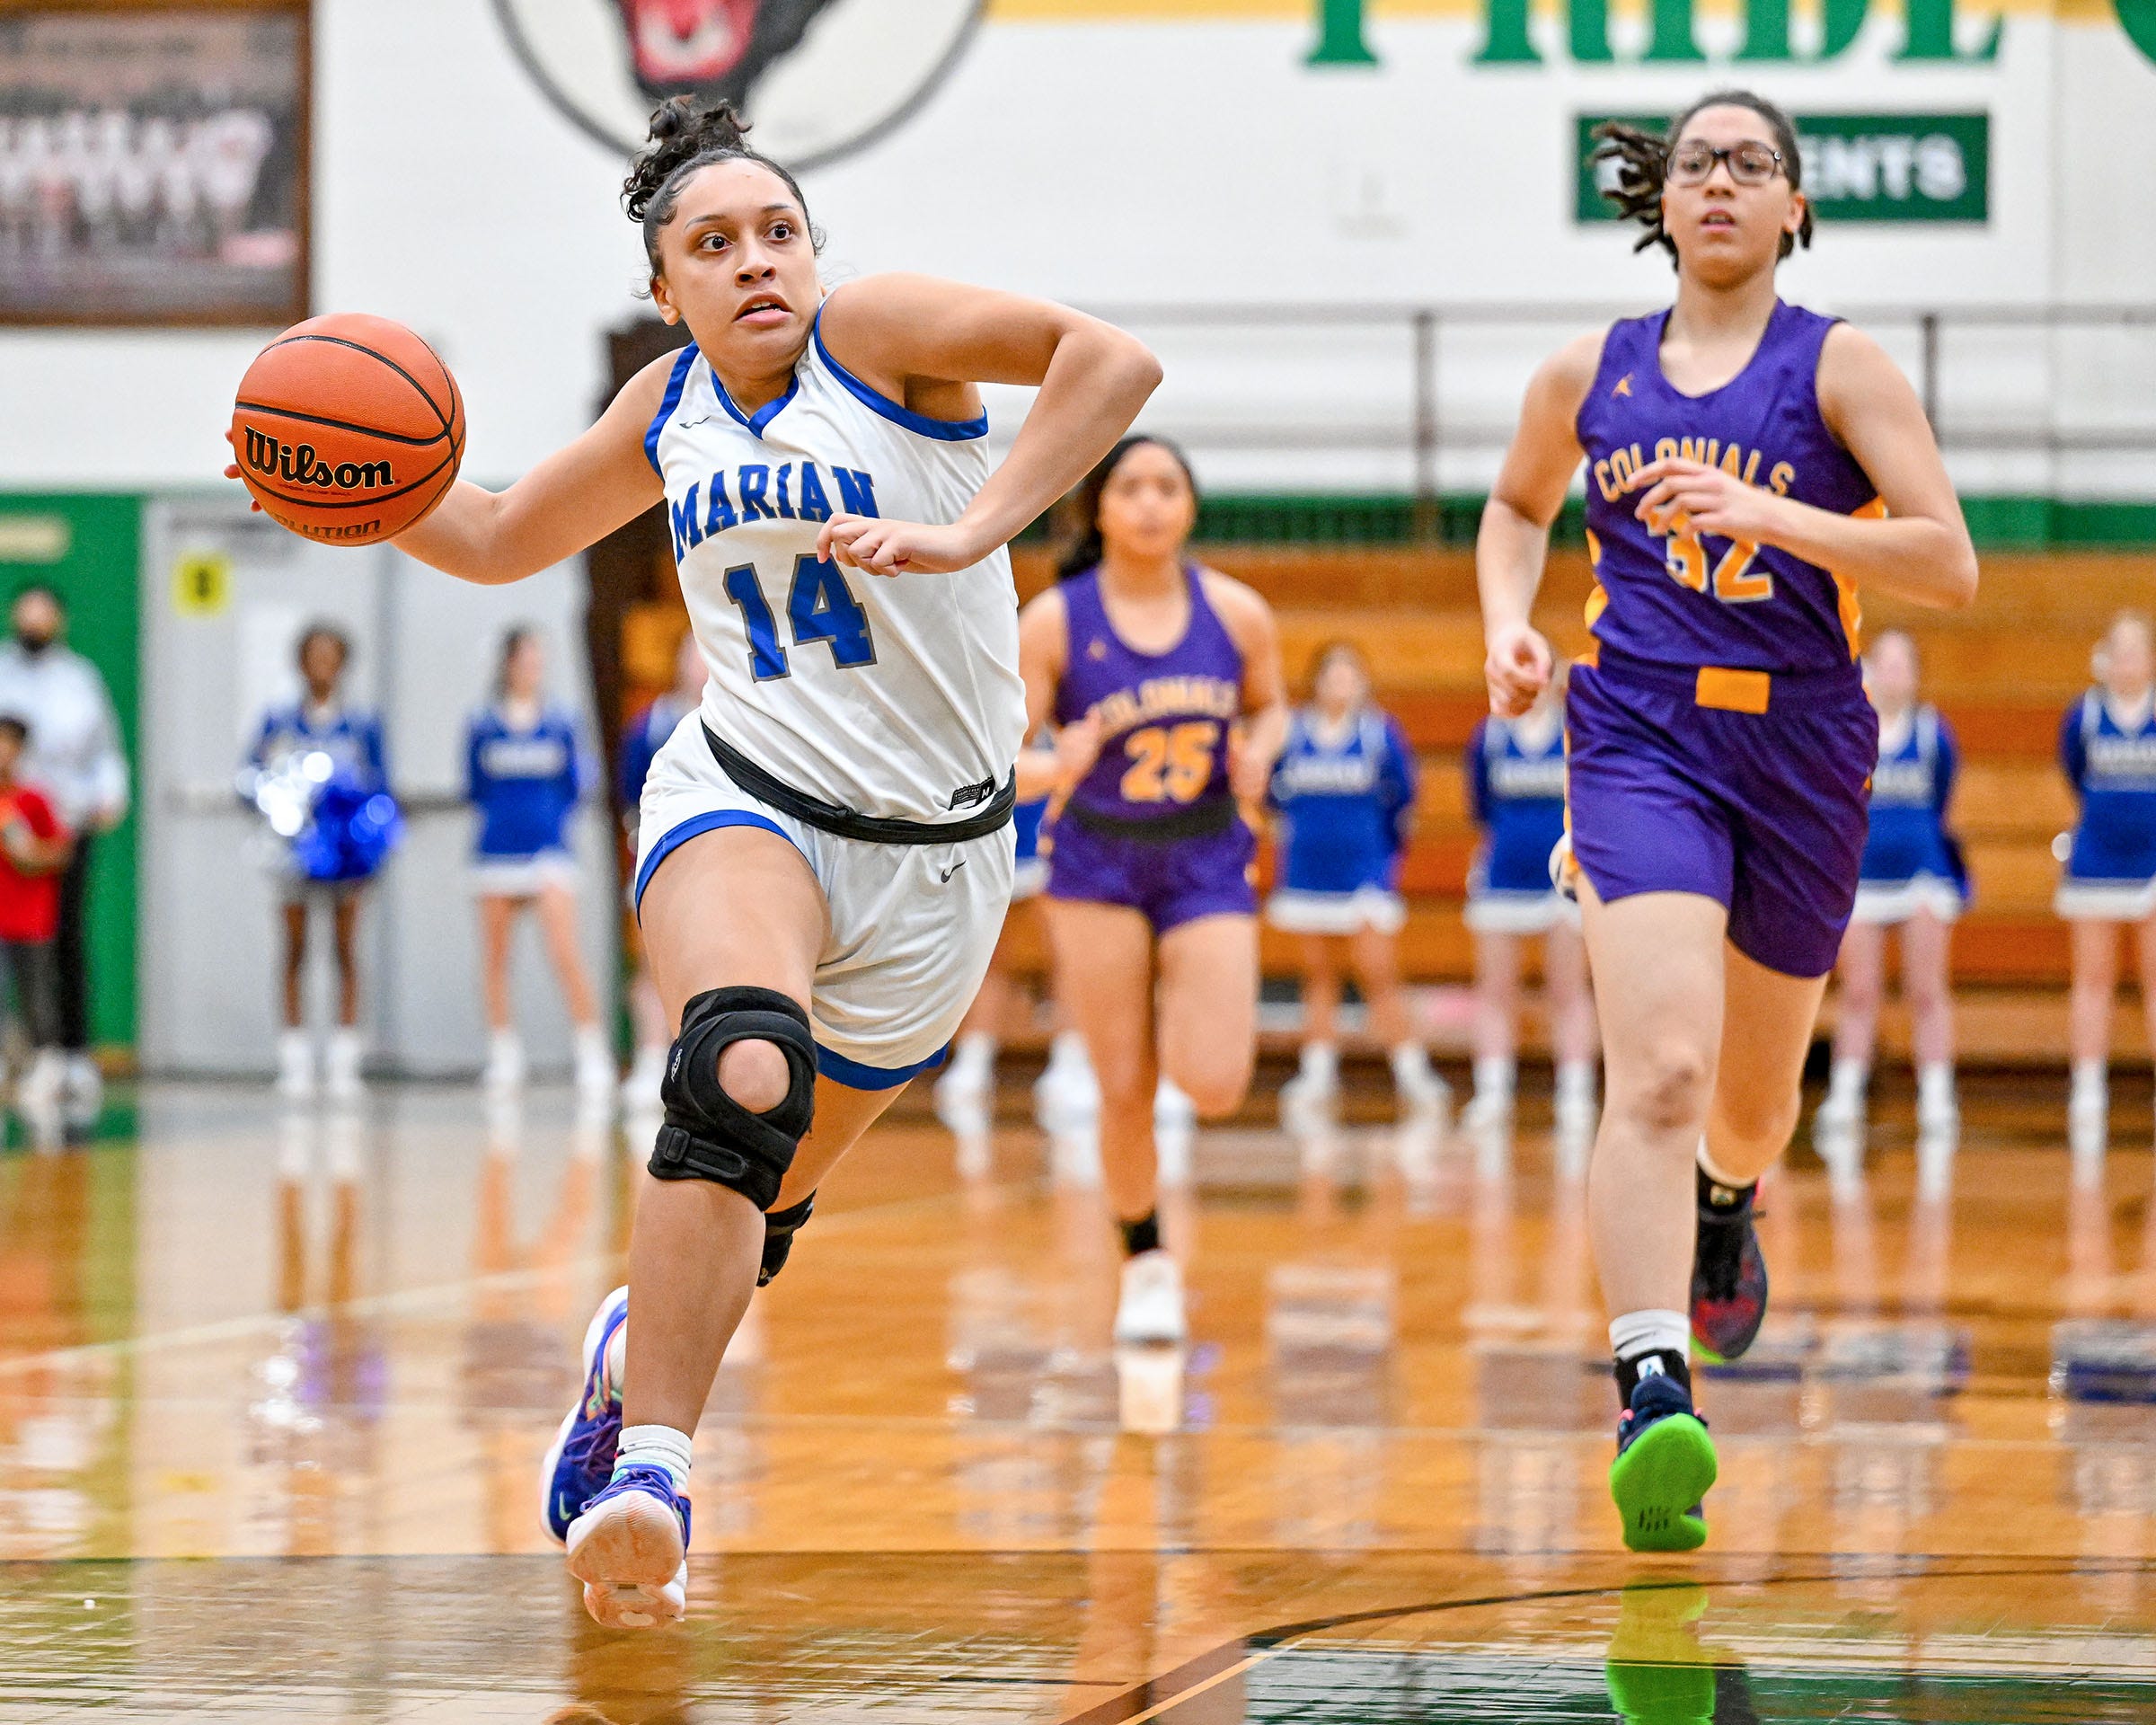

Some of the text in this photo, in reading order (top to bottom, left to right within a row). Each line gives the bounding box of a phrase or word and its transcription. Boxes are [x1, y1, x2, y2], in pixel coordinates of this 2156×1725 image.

[244, 424, 395, 490] Wilson
[671, 460, 880, 566] MARIAN
[722, 553, 878, 684] 14
[1119, 721, 1219, 803] 25
